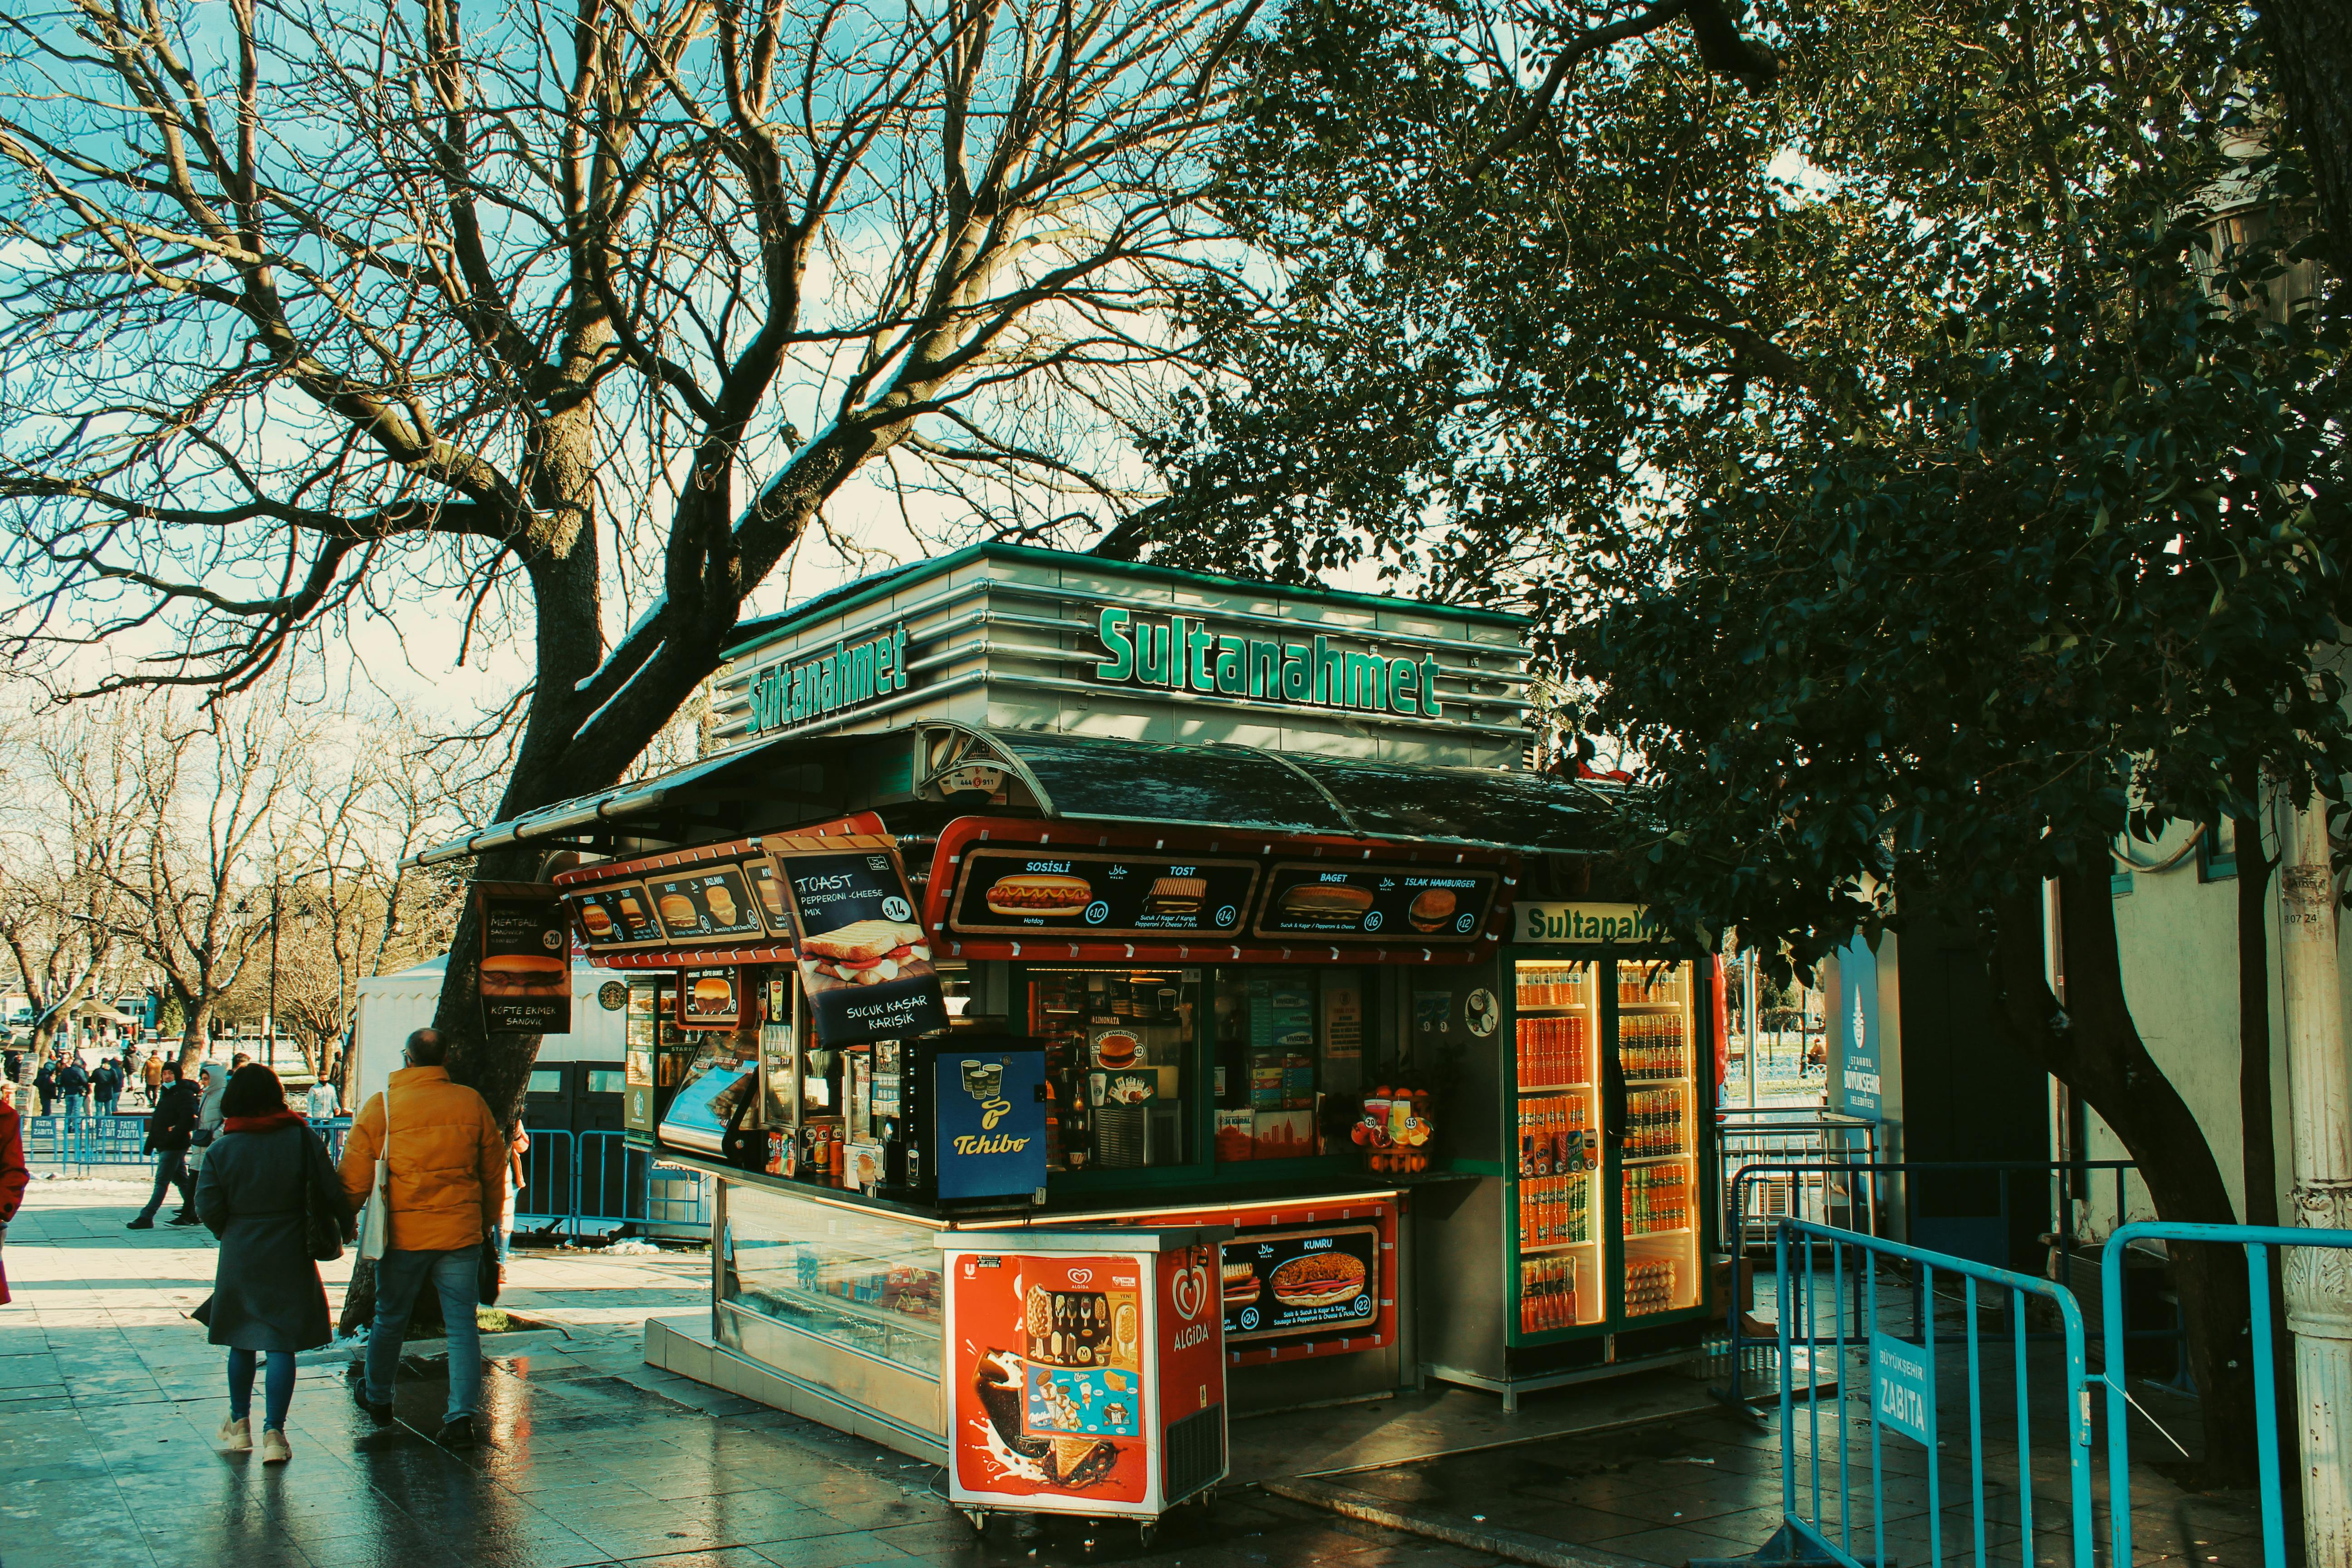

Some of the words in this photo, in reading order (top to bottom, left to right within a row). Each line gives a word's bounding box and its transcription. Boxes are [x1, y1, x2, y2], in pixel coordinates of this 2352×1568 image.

[1097, 607, 1443, 717] Sultanahmet
[746, 621, 907, 735] Sultanahmet
[1026, 861, 1071, 872] SOSİSLİ
[1170, 866, 1196, 876] TOST
[704, 875, 725, 886] BAZLAMA
[795, 874, 853, 892] TOAST
[1320, 873, 1348, 882] BAGET
[1405, 878, 1427, 887] ISLAK
[1430, 879, 1475, 888] HAMBURGER
[801, 892, 847, 905] PEPPERONI
[805, 908, 822, 916] MIX
[491, 918, 538, 926] MEATBALL
[1528, 907, 1672, 939] Sultanah
[2304, 914, 2317, 922] 24
[601, 982, 625, 995] STARBUCKS
[525, 1006, 556, 1015] EKMEK
[603, 1001, 621, 1009] COFFEE
[847, 1004, 884, 1019] SUCUK
[887, 995, 927, 1012] KAŞAR
[869, 1013, 915, 1030] KARIŞIK
[1096, 1033, 1107, 1042] WET
[1108, 1030, 1137, 1040] HAMBURGER
[1844, 1065, 1880, 1097] BÜYÜKŞEHİR
[117, 1130, 140, 1138] ZABITA
[954, 1134, 1030, 1155] Tchibo
[1304, 1239, 1332, 1250] KUMRU
[1297, 1315, 1318, 1324] Pepperoni
[1880, 1349, 1923, 1381] BÜYÜKŞEHİR
[1881, 1377, 1924, 1431] ZABITA
